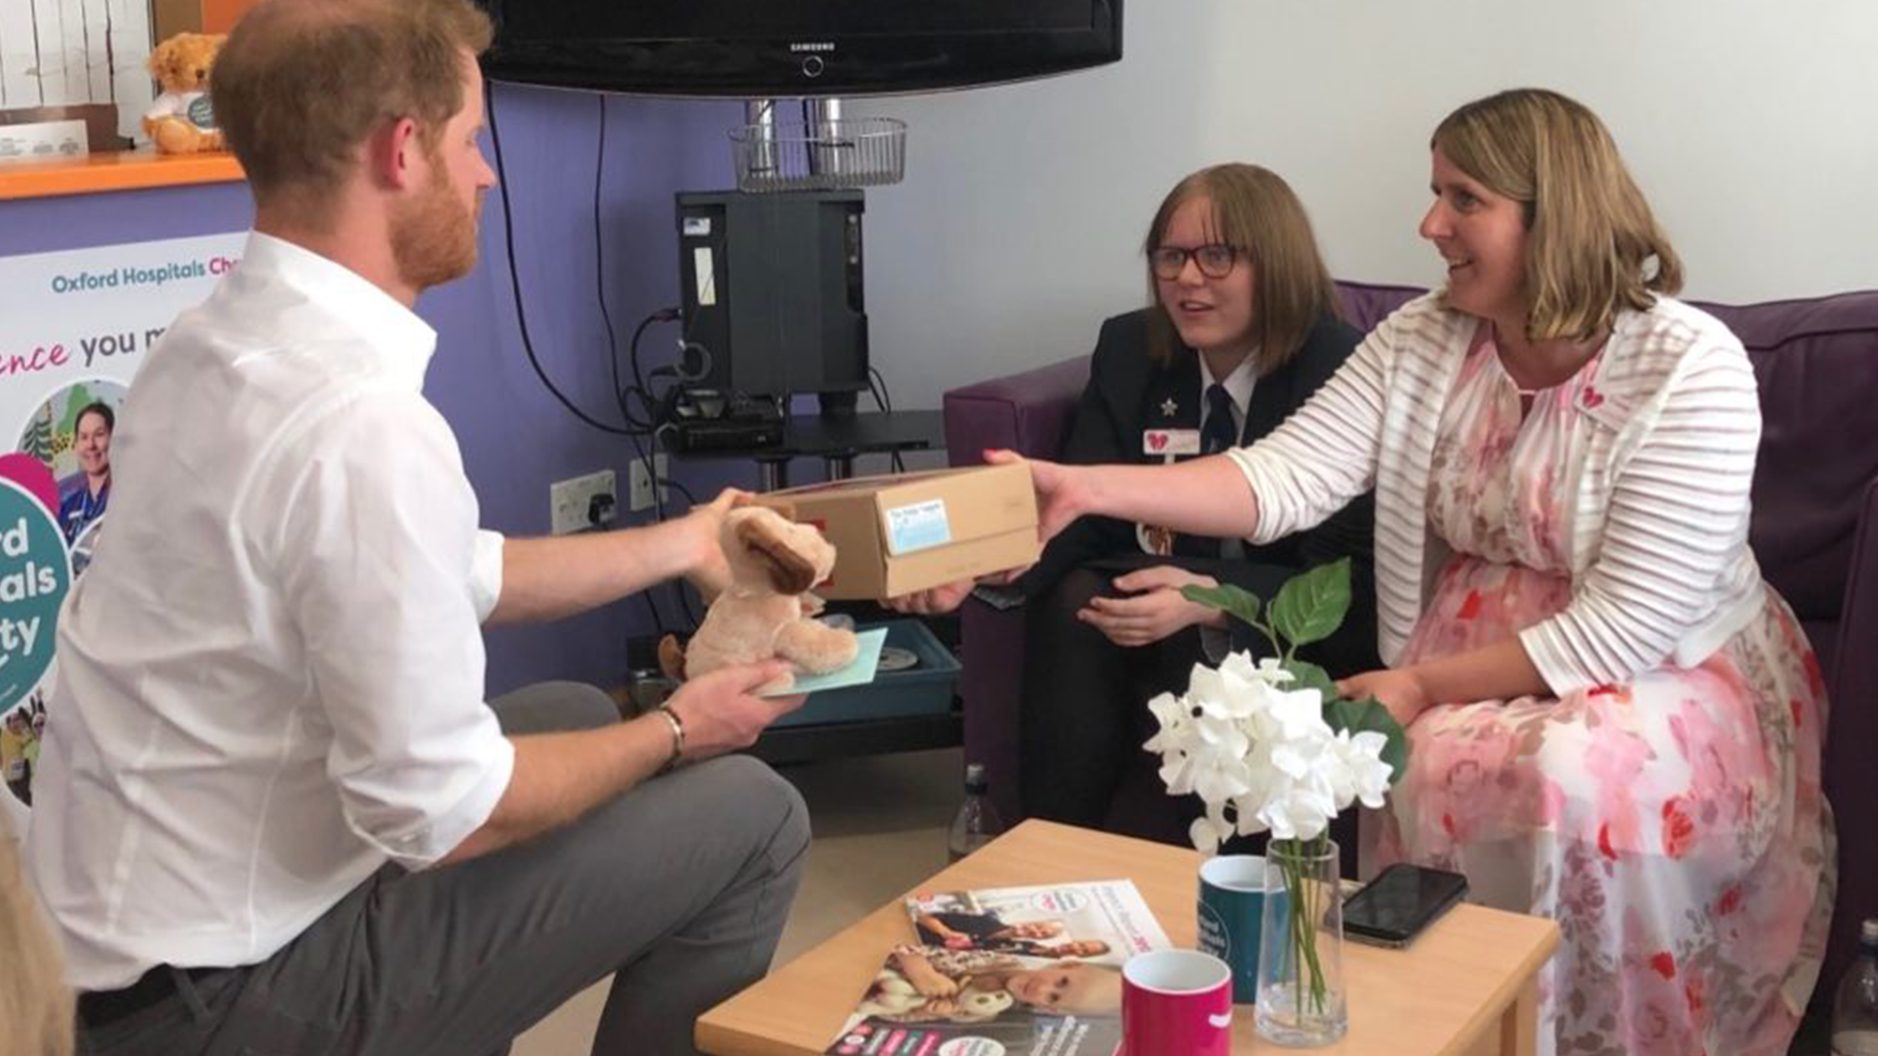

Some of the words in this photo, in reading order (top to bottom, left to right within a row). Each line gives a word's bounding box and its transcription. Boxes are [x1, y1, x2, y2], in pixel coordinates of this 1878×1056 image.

[52, 269, 118, 294] Oxford
[122, 260, 205, 285] Hospitals
[209, 257, 238, 275] Ch
[80, 332, 136, 368] you
